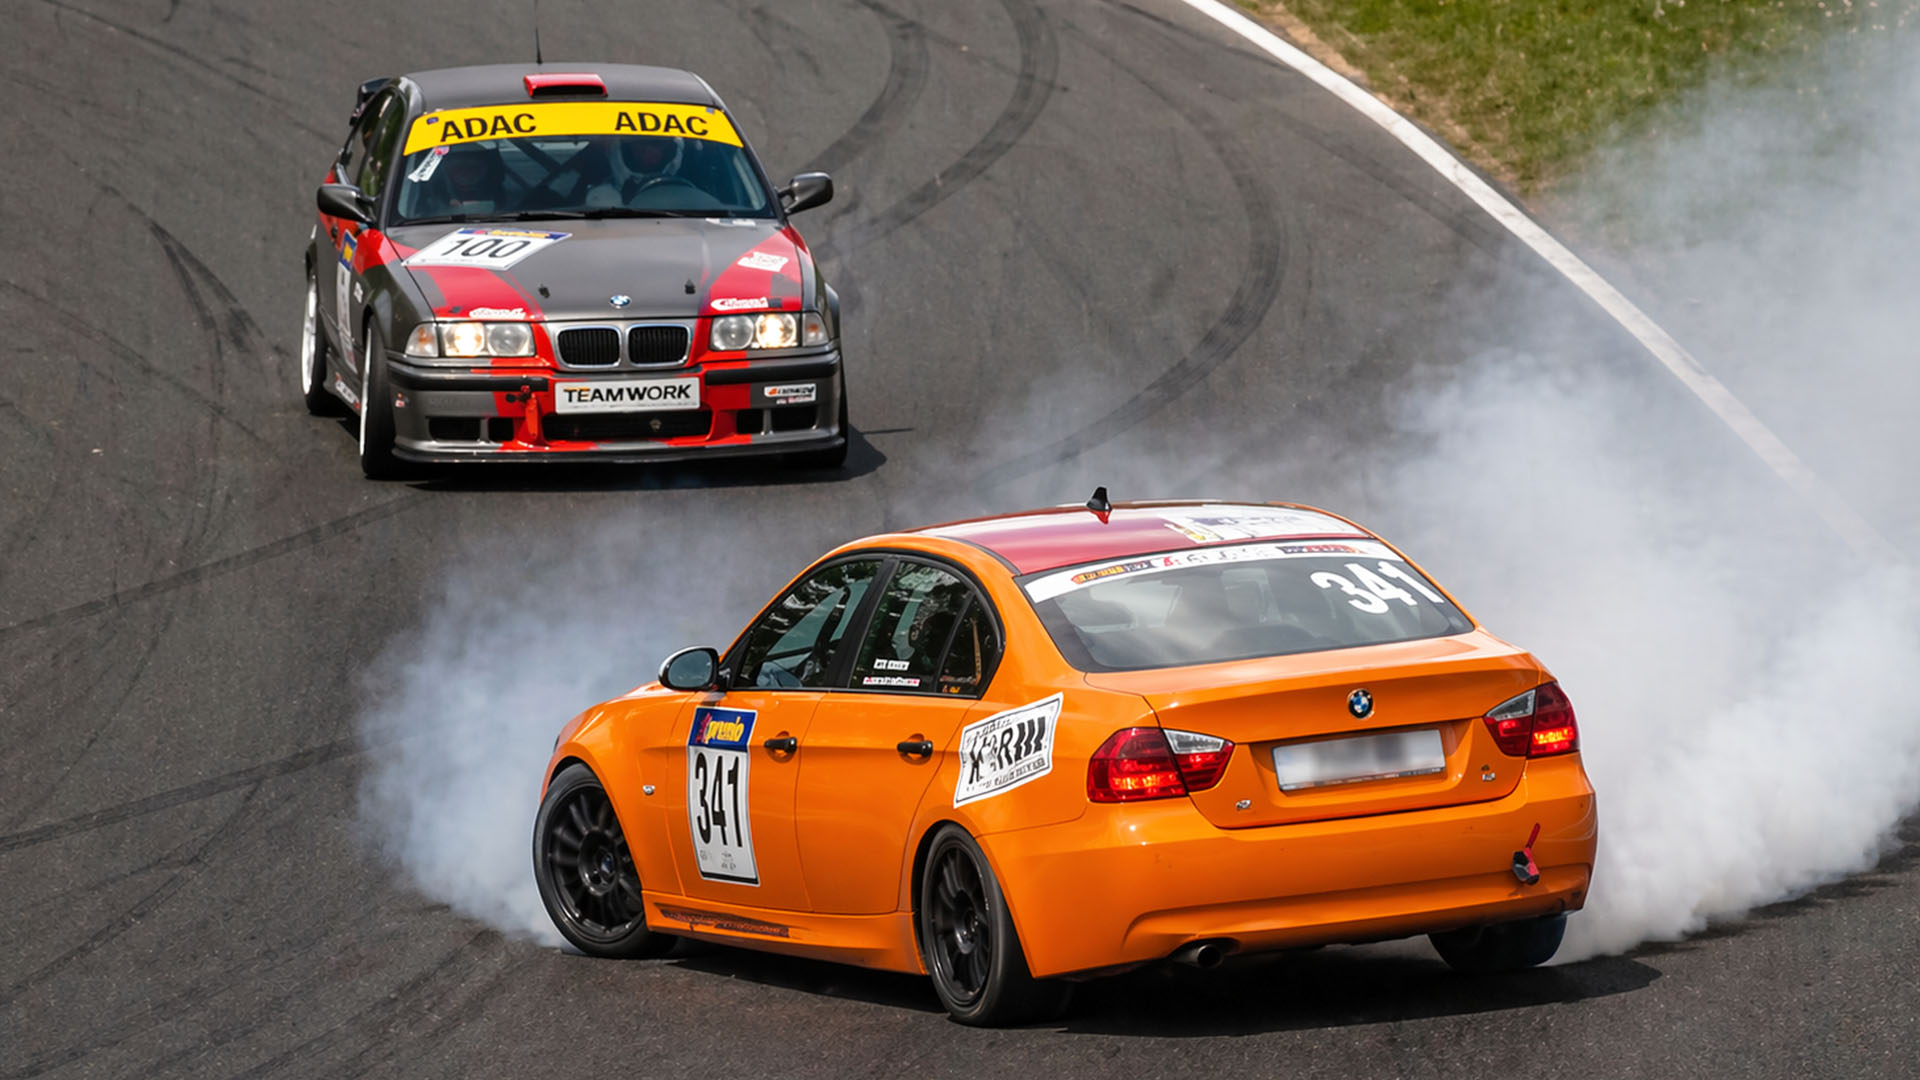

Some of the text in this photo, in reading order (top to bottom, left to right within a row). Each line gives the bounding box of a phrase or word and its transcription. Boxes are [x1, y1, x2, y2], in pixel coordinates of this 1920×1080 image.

[440, 111, 709, 142] ADAC ADAC
[441, 237, 531, 259] 100
[563, 383, 692, 403] TEAMWORK
[1310, 560, 1445, 614] 341
[695, 752, 743, 848] 341
